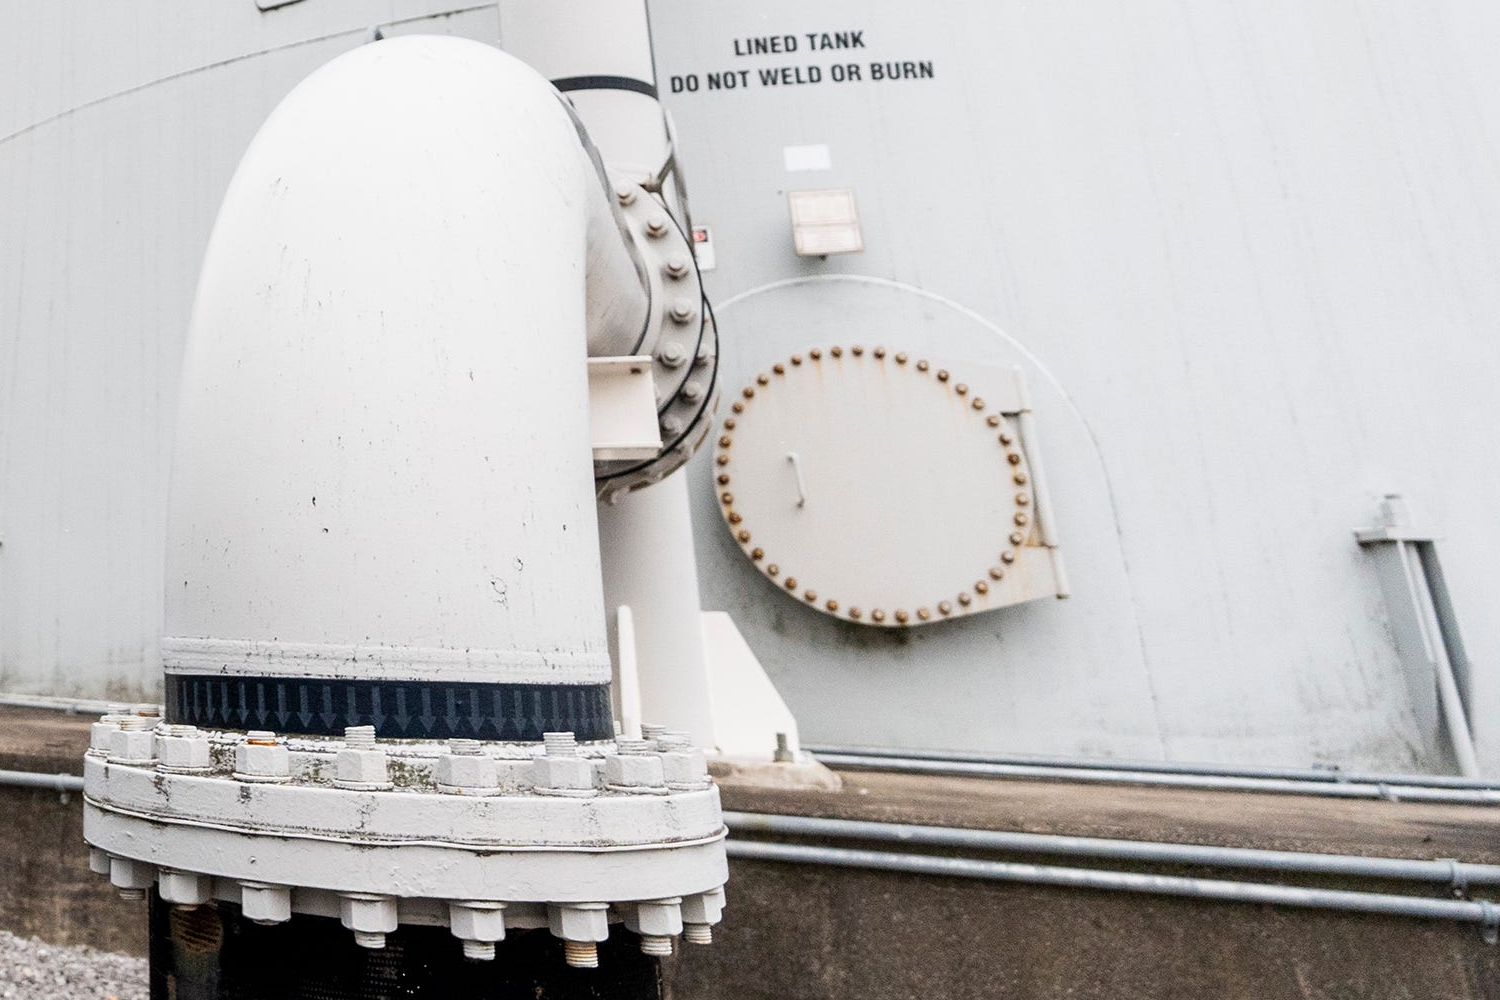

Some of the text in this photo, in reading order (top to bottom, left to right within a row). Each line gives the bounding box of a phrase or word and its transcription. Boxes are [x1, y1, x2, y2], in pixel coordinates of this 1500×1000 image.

[734, 31, 866, 56] LINED TANK
[670, 61, 934, 93] DO NOT WELD OR BURN
